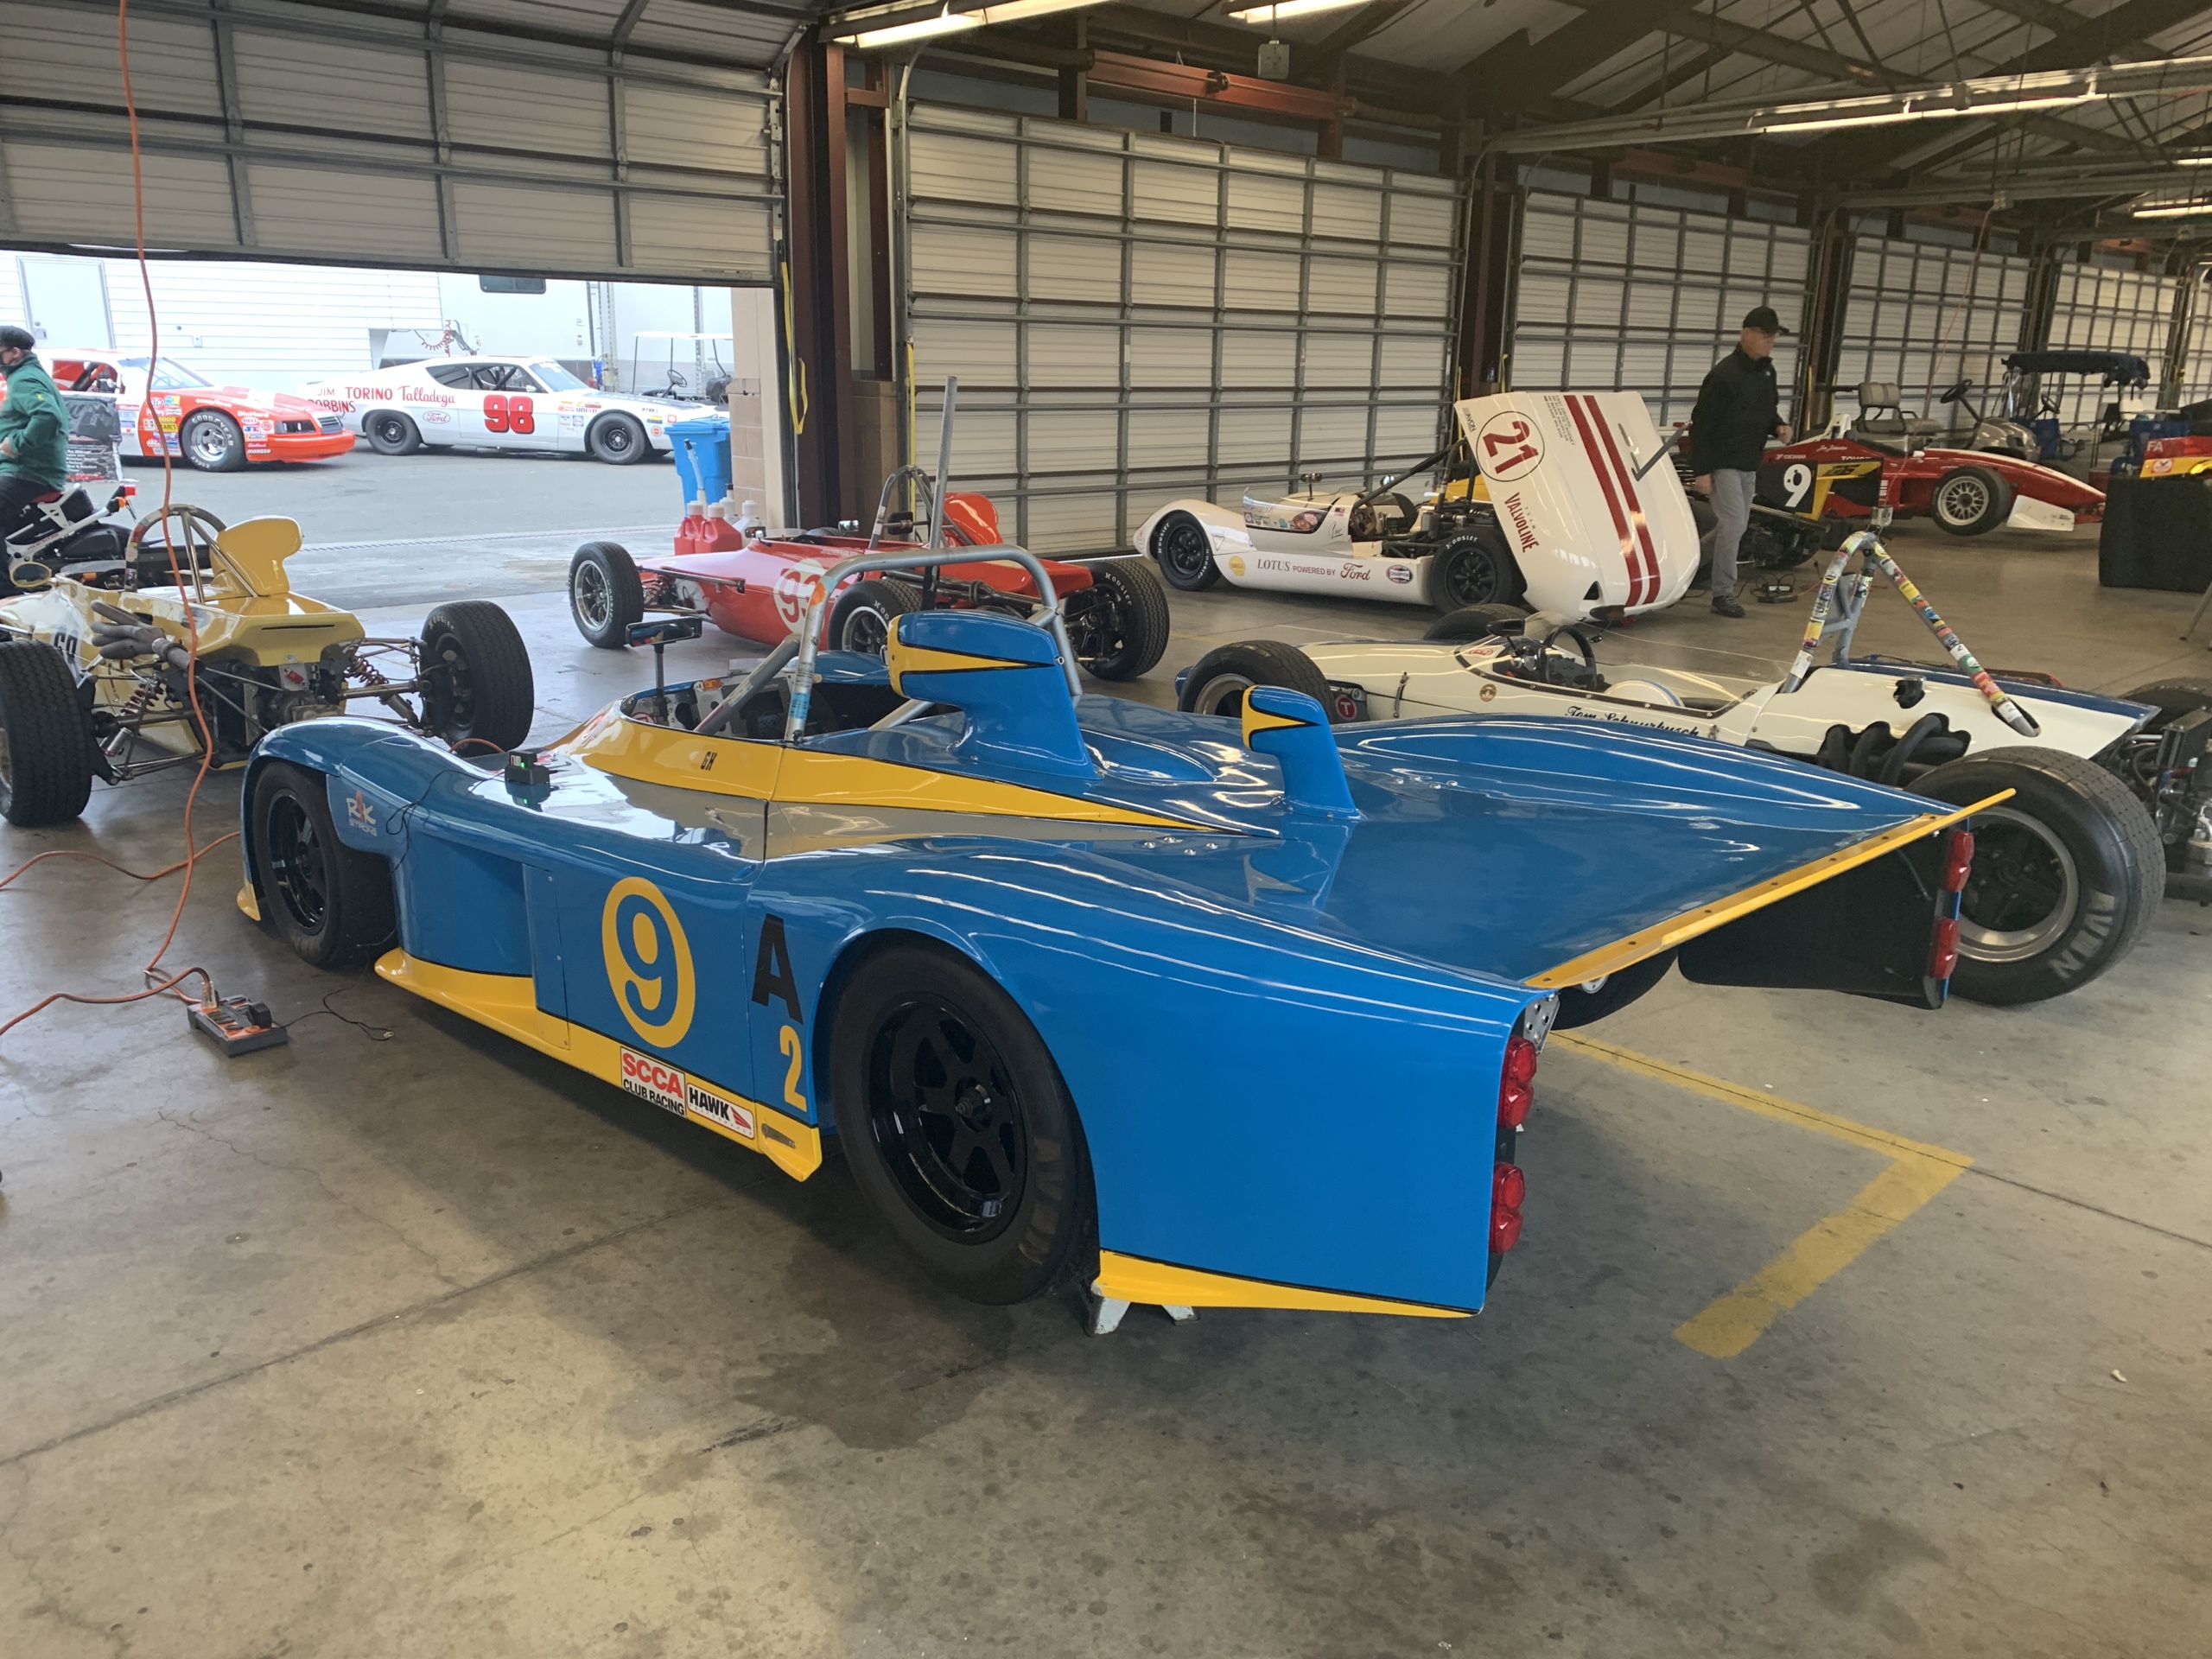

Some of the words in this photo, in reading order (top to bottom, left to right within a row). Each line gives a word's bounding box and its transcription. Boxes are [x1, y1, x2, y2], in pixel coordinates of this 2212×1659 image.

[317, 388, 335, 397] JIM
[345, 387, 393, 401] TORINO
[397, 385, 456, 408] Talladega
[192, 415, 234, 447] GOODYEAR
[426, 412, 448, 423] Ford
[483, 394, 535, 435] 98
[1465, 413, 1477, 432] AVON
[1482, 420, 1539, 474] 21
[2147, 440, 2164, 452] FA
[1783, 463, 1812, 508] 9
[1504, 492, 1541, 554] VALVOLINE
[1257, 558, 1291, 572] LOTUS
[1293, 565, 1325, 575] POWERED
[1326, 568, 1336, 576] BY
[1340, 563, 1372, 582] Ford
[1389, 569, 1410, 578] CHAMPION
[1340, 702, 1351, 715] T
[1564, 705, 1597, 720] Tom
[615, 893, 679, 1027] 9
[751, 912, 804, 1026] A
[622, 1052, 683, 1099] SCCA
[779, 1024, 807, 1113] 2
[623, 1078, 648, 1098] CLUB
[649, 1089, 685, 1116] RACING
[689, 1086, 730, 1122] HAWK
